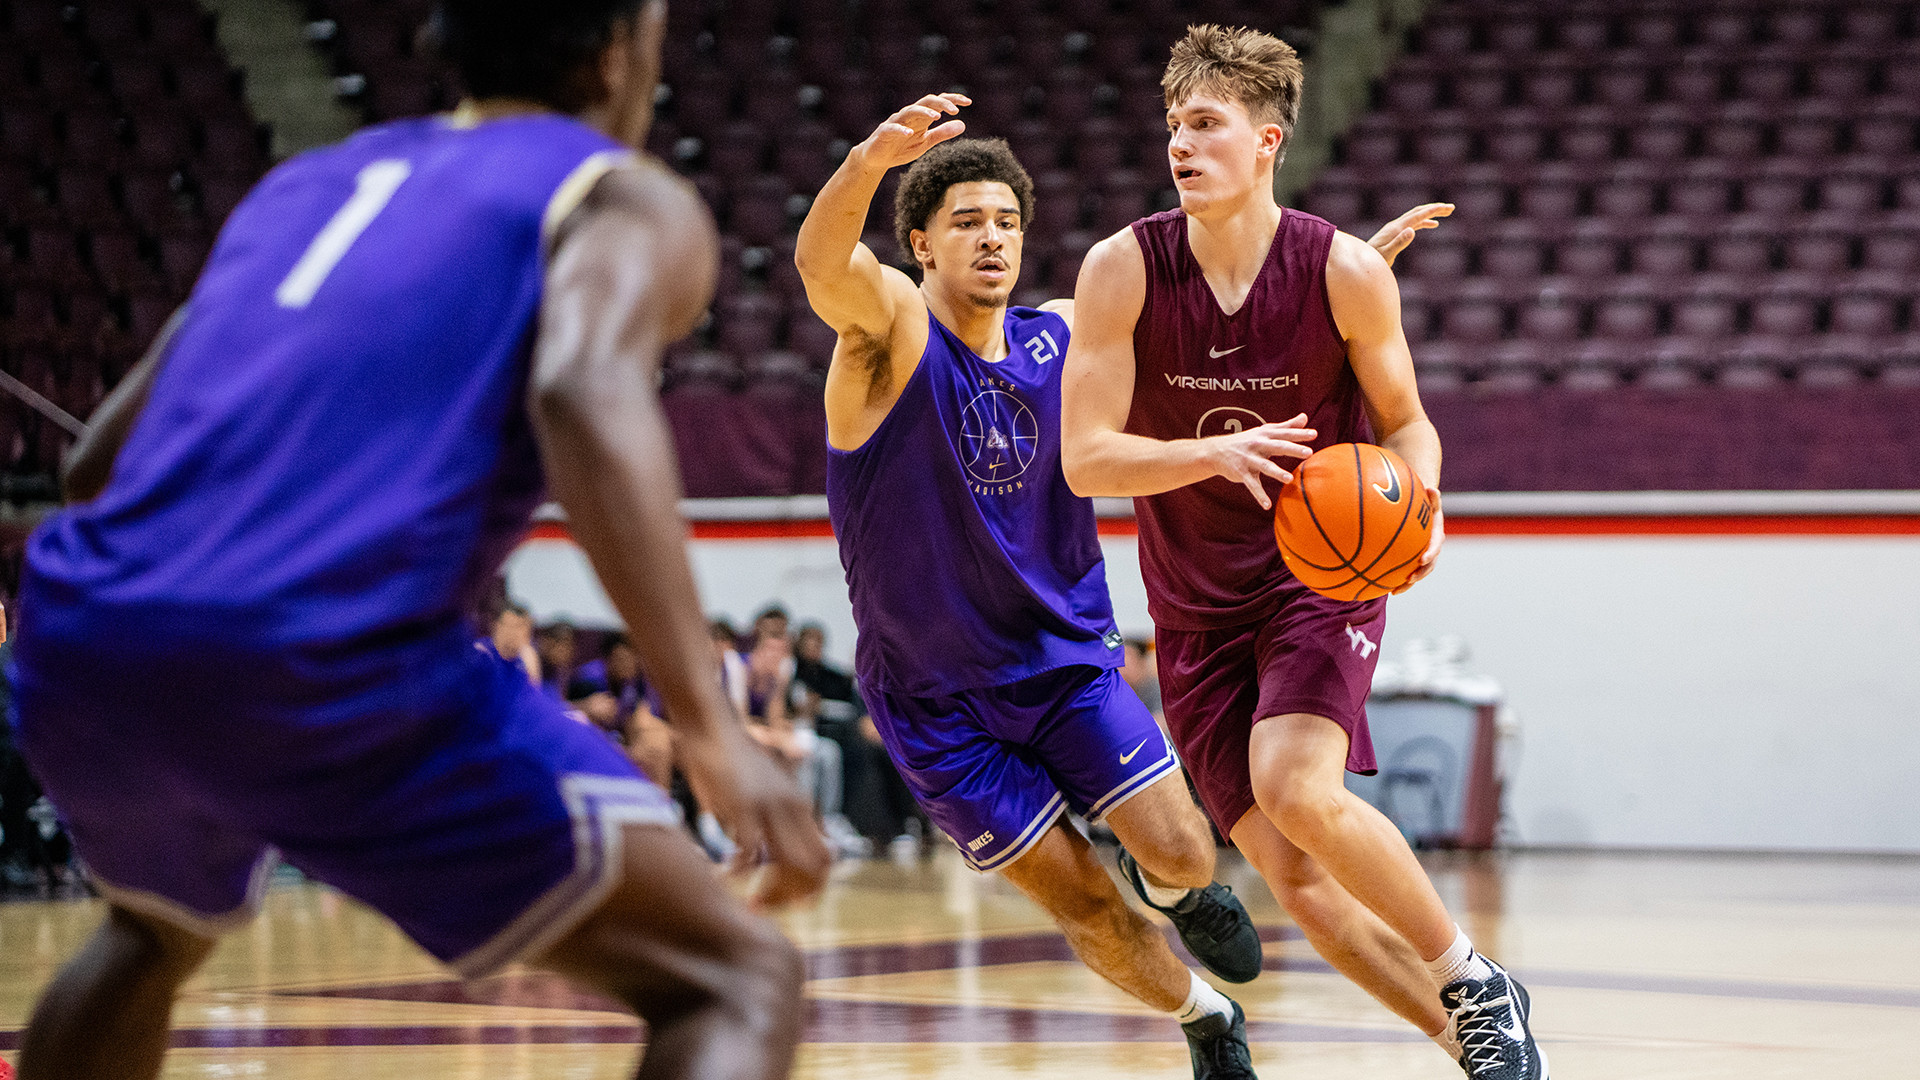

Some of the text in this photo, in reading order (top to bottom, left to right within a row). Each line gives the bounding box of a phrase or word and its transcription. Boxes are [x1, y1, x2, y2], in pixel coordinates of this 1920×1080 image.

[275, 159, 412, 309] 1
[1024, 329, 1060, 365] 21
[979, 377, 1017, 393] AMES
[1164, 372, 1299, 391] VIRGINIA TECH
[967, 830, 994, 852] DUKES
